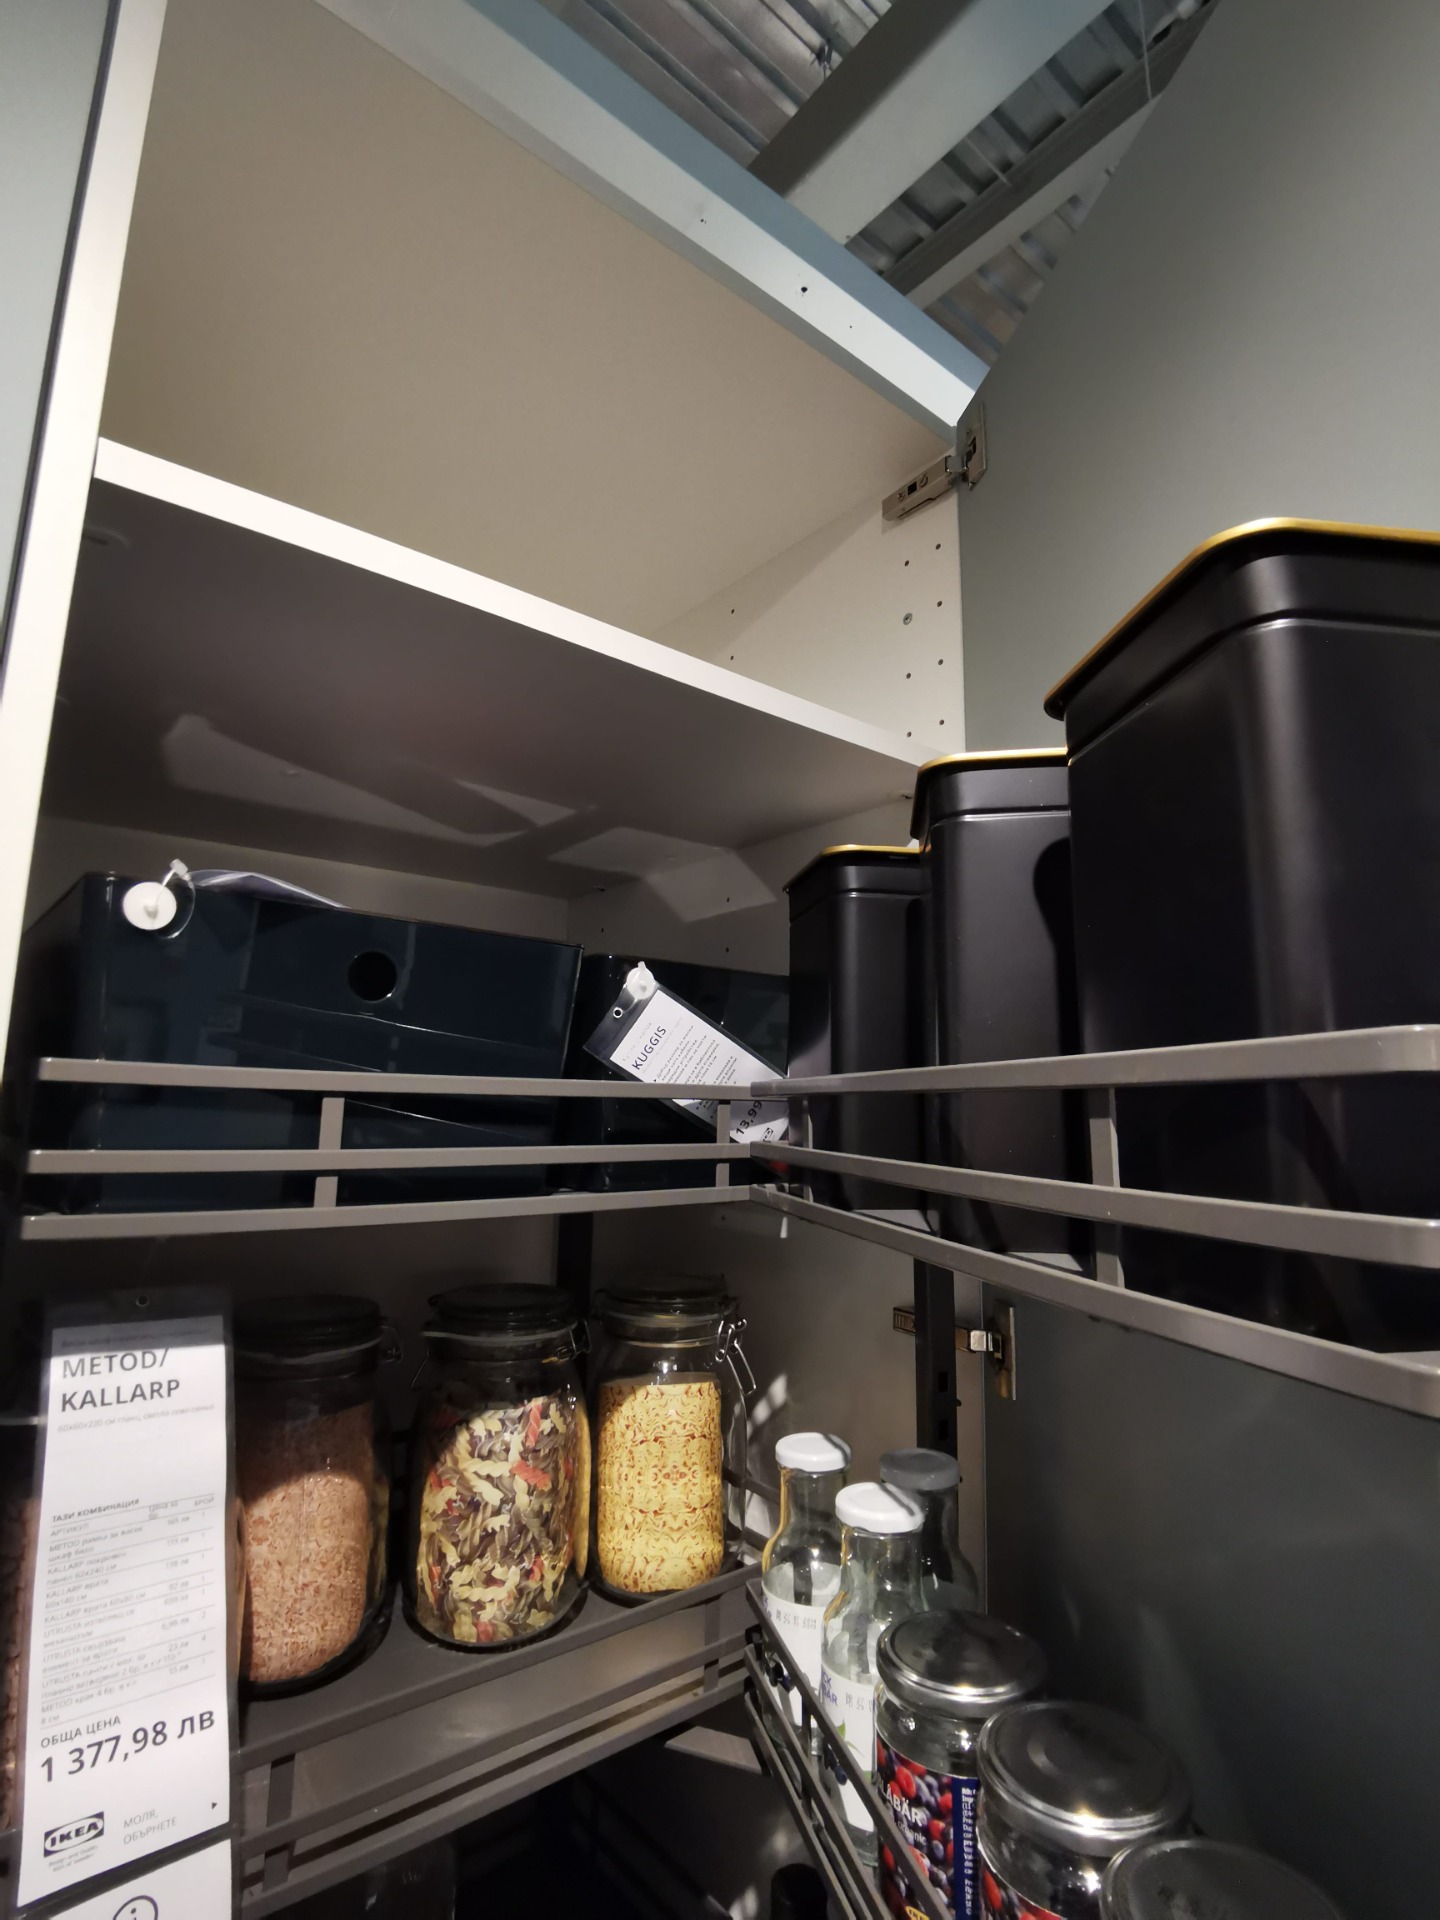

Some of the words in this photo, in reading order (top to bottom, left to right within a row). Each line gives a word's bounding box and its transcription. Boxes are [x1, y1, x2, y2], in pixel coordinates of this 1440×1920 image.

[632, 1026, 667, 1070] KUGGIS
[62, 1348, 170, 1379] METOD/
[60, 1379, 181, 1413] KALLARP
[40, 1726, 83, 1749] ОБЩА
[86, 1715, 122, 1736] ЦЕНА
[48, 1819, 100, 1849] IKEA
